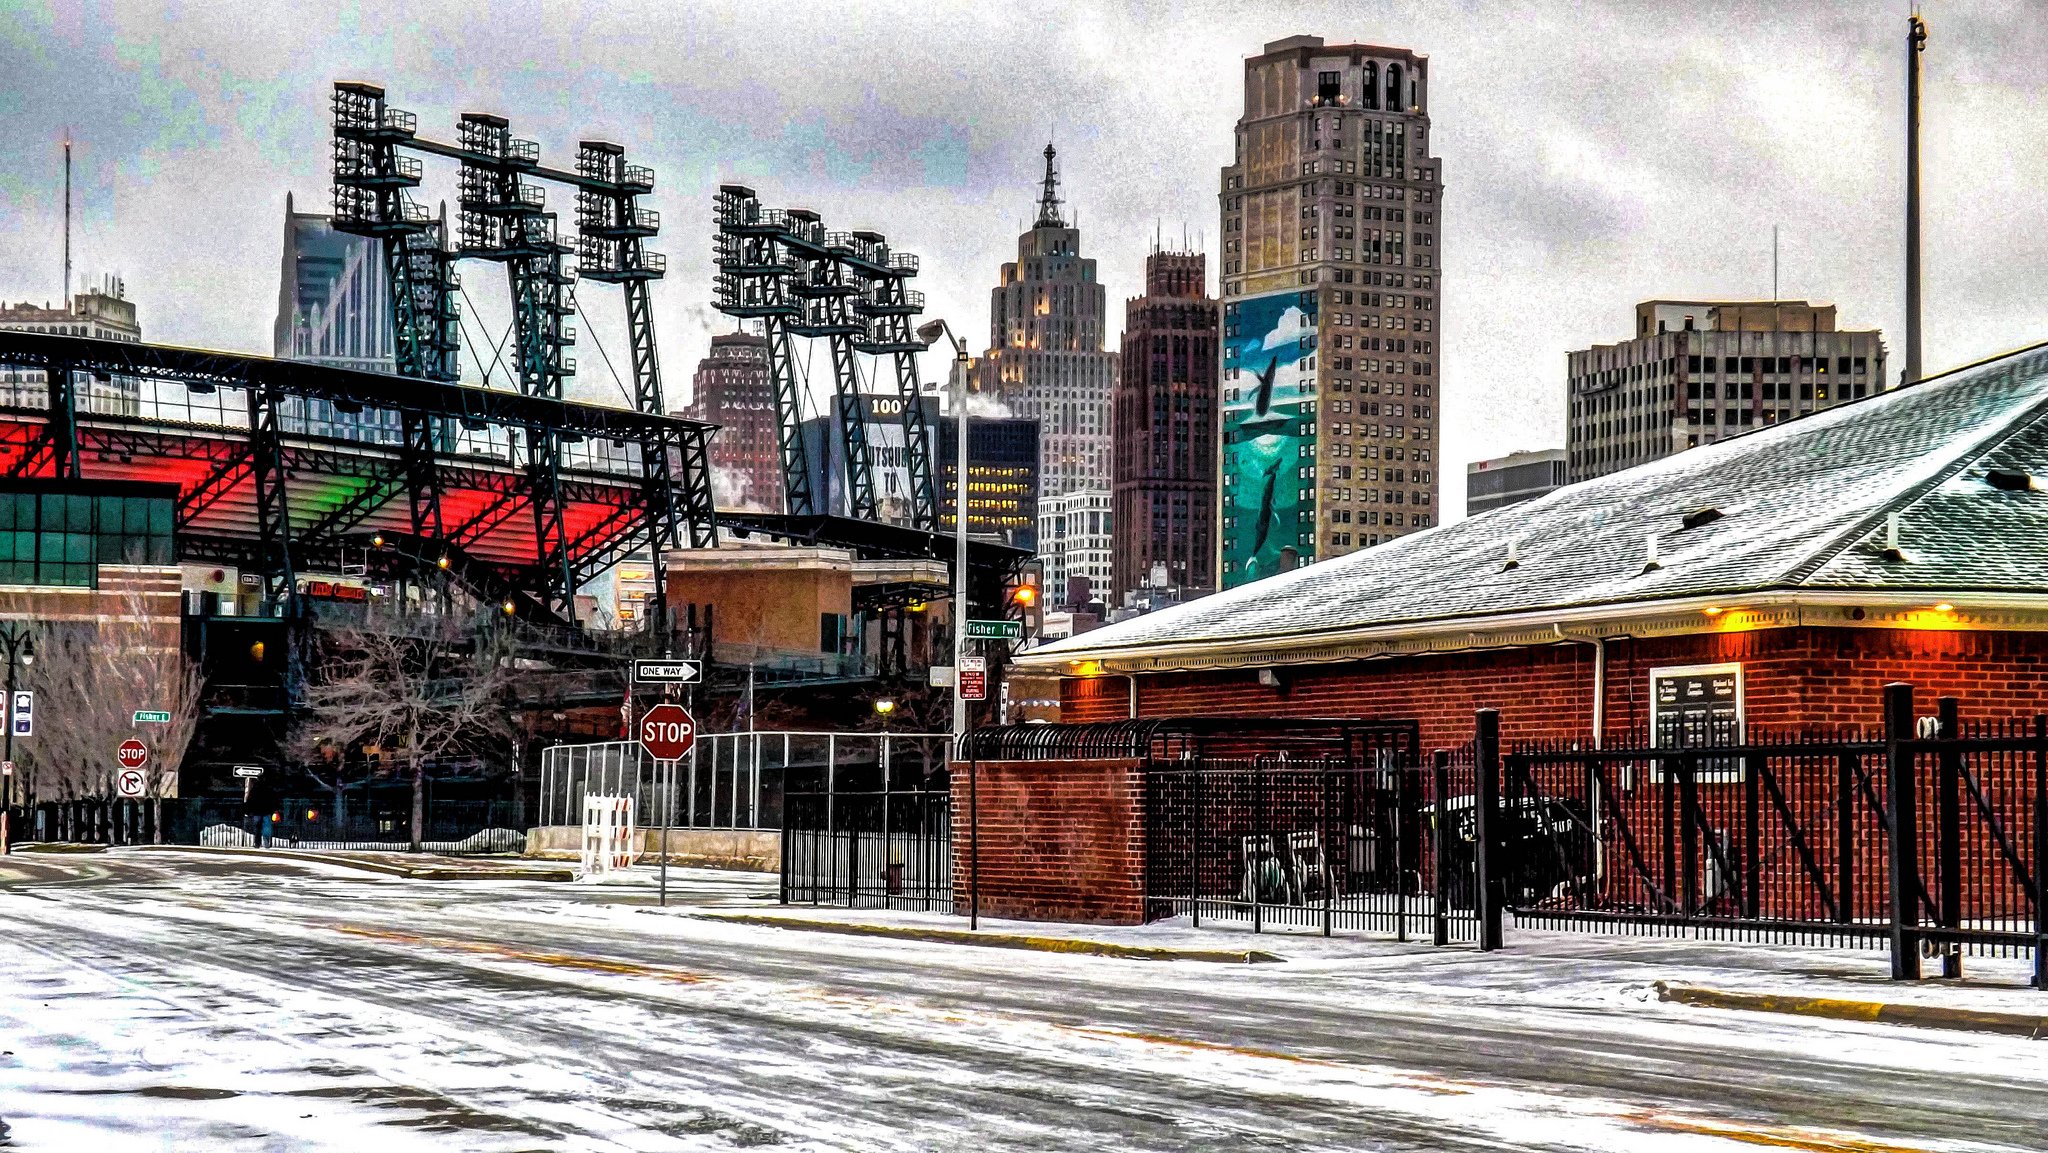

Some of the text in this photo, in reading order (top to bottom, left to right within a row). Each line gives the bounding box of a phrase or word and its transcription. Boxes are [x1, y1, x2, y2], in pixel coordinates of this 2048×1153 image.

[968, 623, 1019, 638] Fisher Fwy
[642, 666, 682, 676] ONE WAY
[644, 721, 692, 743] STOP
[119, 748, 145, 760] STOP
